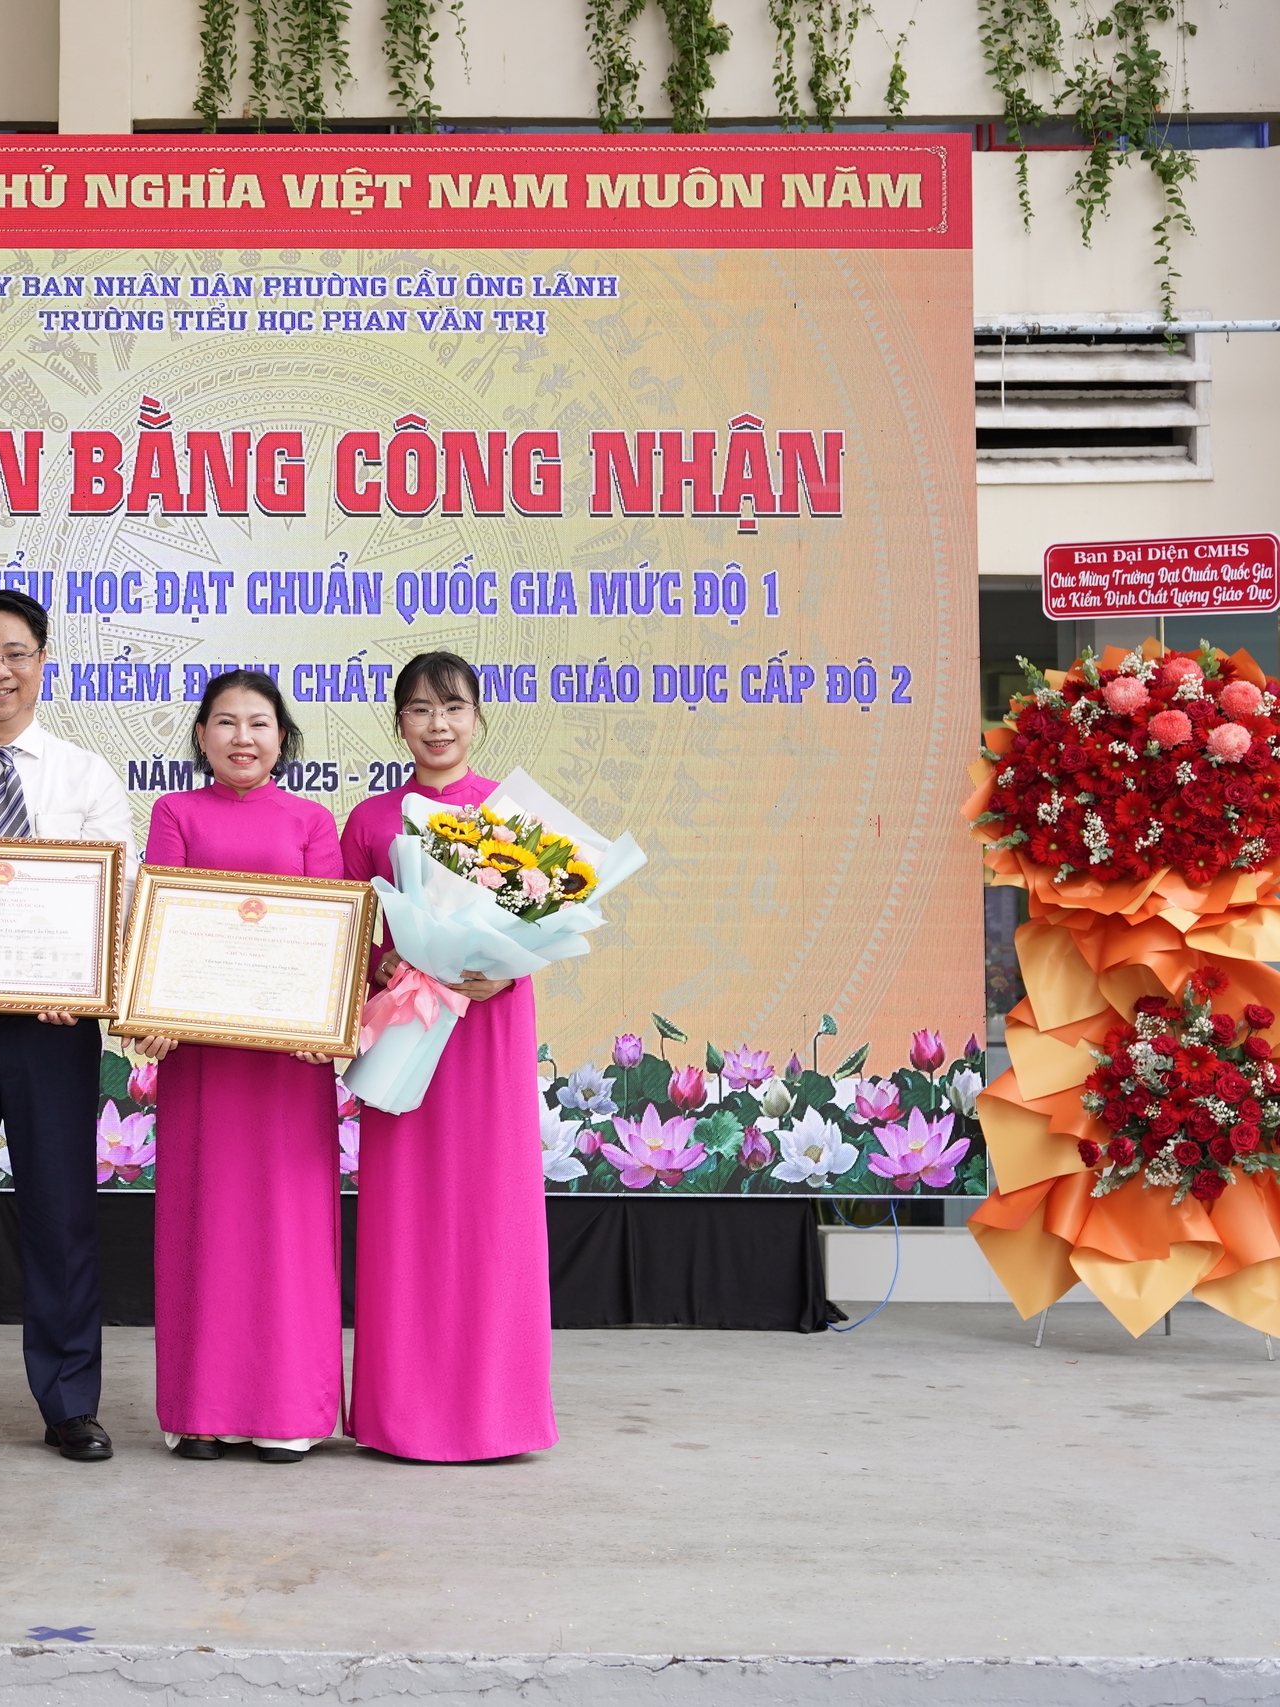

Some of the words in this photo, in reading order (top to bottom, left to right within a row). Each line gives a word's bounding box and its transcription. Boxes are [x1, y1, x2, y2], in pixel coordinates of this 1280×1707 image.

[84, 167, 266, 208] NGHĨA
[282, 167, 412, 215] VIỆT
[428, 173, 571, 208] NAM
[586, 167, 763, 208] MUÔN
[781, 166, 922, 208] NĂM
[22, 277, 85, 296] BAN
[94, 273, 181, 296] NHÂN
[190, 273, 253, 296] DÂN
[263, 272, 387, 296] PHƯỜNG
[397, 270, 457, 296] CẦU
[466, 273, 523, 296] ÔNG
[533, 272, 618, 296] LÃNH
[39, 306, 164, 331] TRƯỜNG
[174, 303, 248, 331] TIỂU
[258, 311, 313, 334] HỌC
[323, 311, 407, 331] PHAN
[417, 308, 483, 331] VĂN
[494, 311, 547, 335] TRỊ
[69, 394, 307, 517] BẰNG
[334, 412, 563, 517] CÔNG
[589, 412, 846, 534] NHẬN
[1074, 551, 1108, 564] Ban
[1113, 547, 1142, 565] Đại
[1147, 545, 1189, 563] Diện
[1194, 543, 1250, 559] CMHS
[66, 570, 142, 622] HỌC
[155, 571, 234, 622] ĐẠT
[247, 551, 383, 615] CHUẨN
[396, 554, 498, 624] QUỐC
[511, 571, 578, 615] GIA
[589, 562, 681, 615] MỨC
[694, 562, 747, 625] ĐỘ
[763, 571, 780, 616] 1
[1051, 572, 1077, 588] Chúc
[1078, 570, 1110, 591] Mừng
[1112, 569, 1155, 589] Trường
[1157, 567, 1181, 586] Đạt
[1181, 563, 1219, 583] Chuẩn
[1221, 562, 1250, 583] Quốc
[1252, 562, 1274, 583] Gia
[1051, 593, 1067, 608] và
[1068, 590, 1102, 608] Kiểm
[1104, 590, 1137, 608] Định
[1138, 587, 1168, 605] Chất
[1170, 587, 1210, 608] Lượng
[1212, 585, 1244, 606] Giáo
[1246, 584, 1273, 603] Dục
[71, 646, 170, 701] KIỂM
[292, 649, 393, 702] CHẤT
[550, 656, 639, 703] GIÁO
[652, 665, 728, 711] DỤC
[741, 650, 815, 703] CẤP
[827, 657, 877, 711] ĐỘ
[891, 665, 912, 703] 2
[128, 754, 194, 791] NĂM
